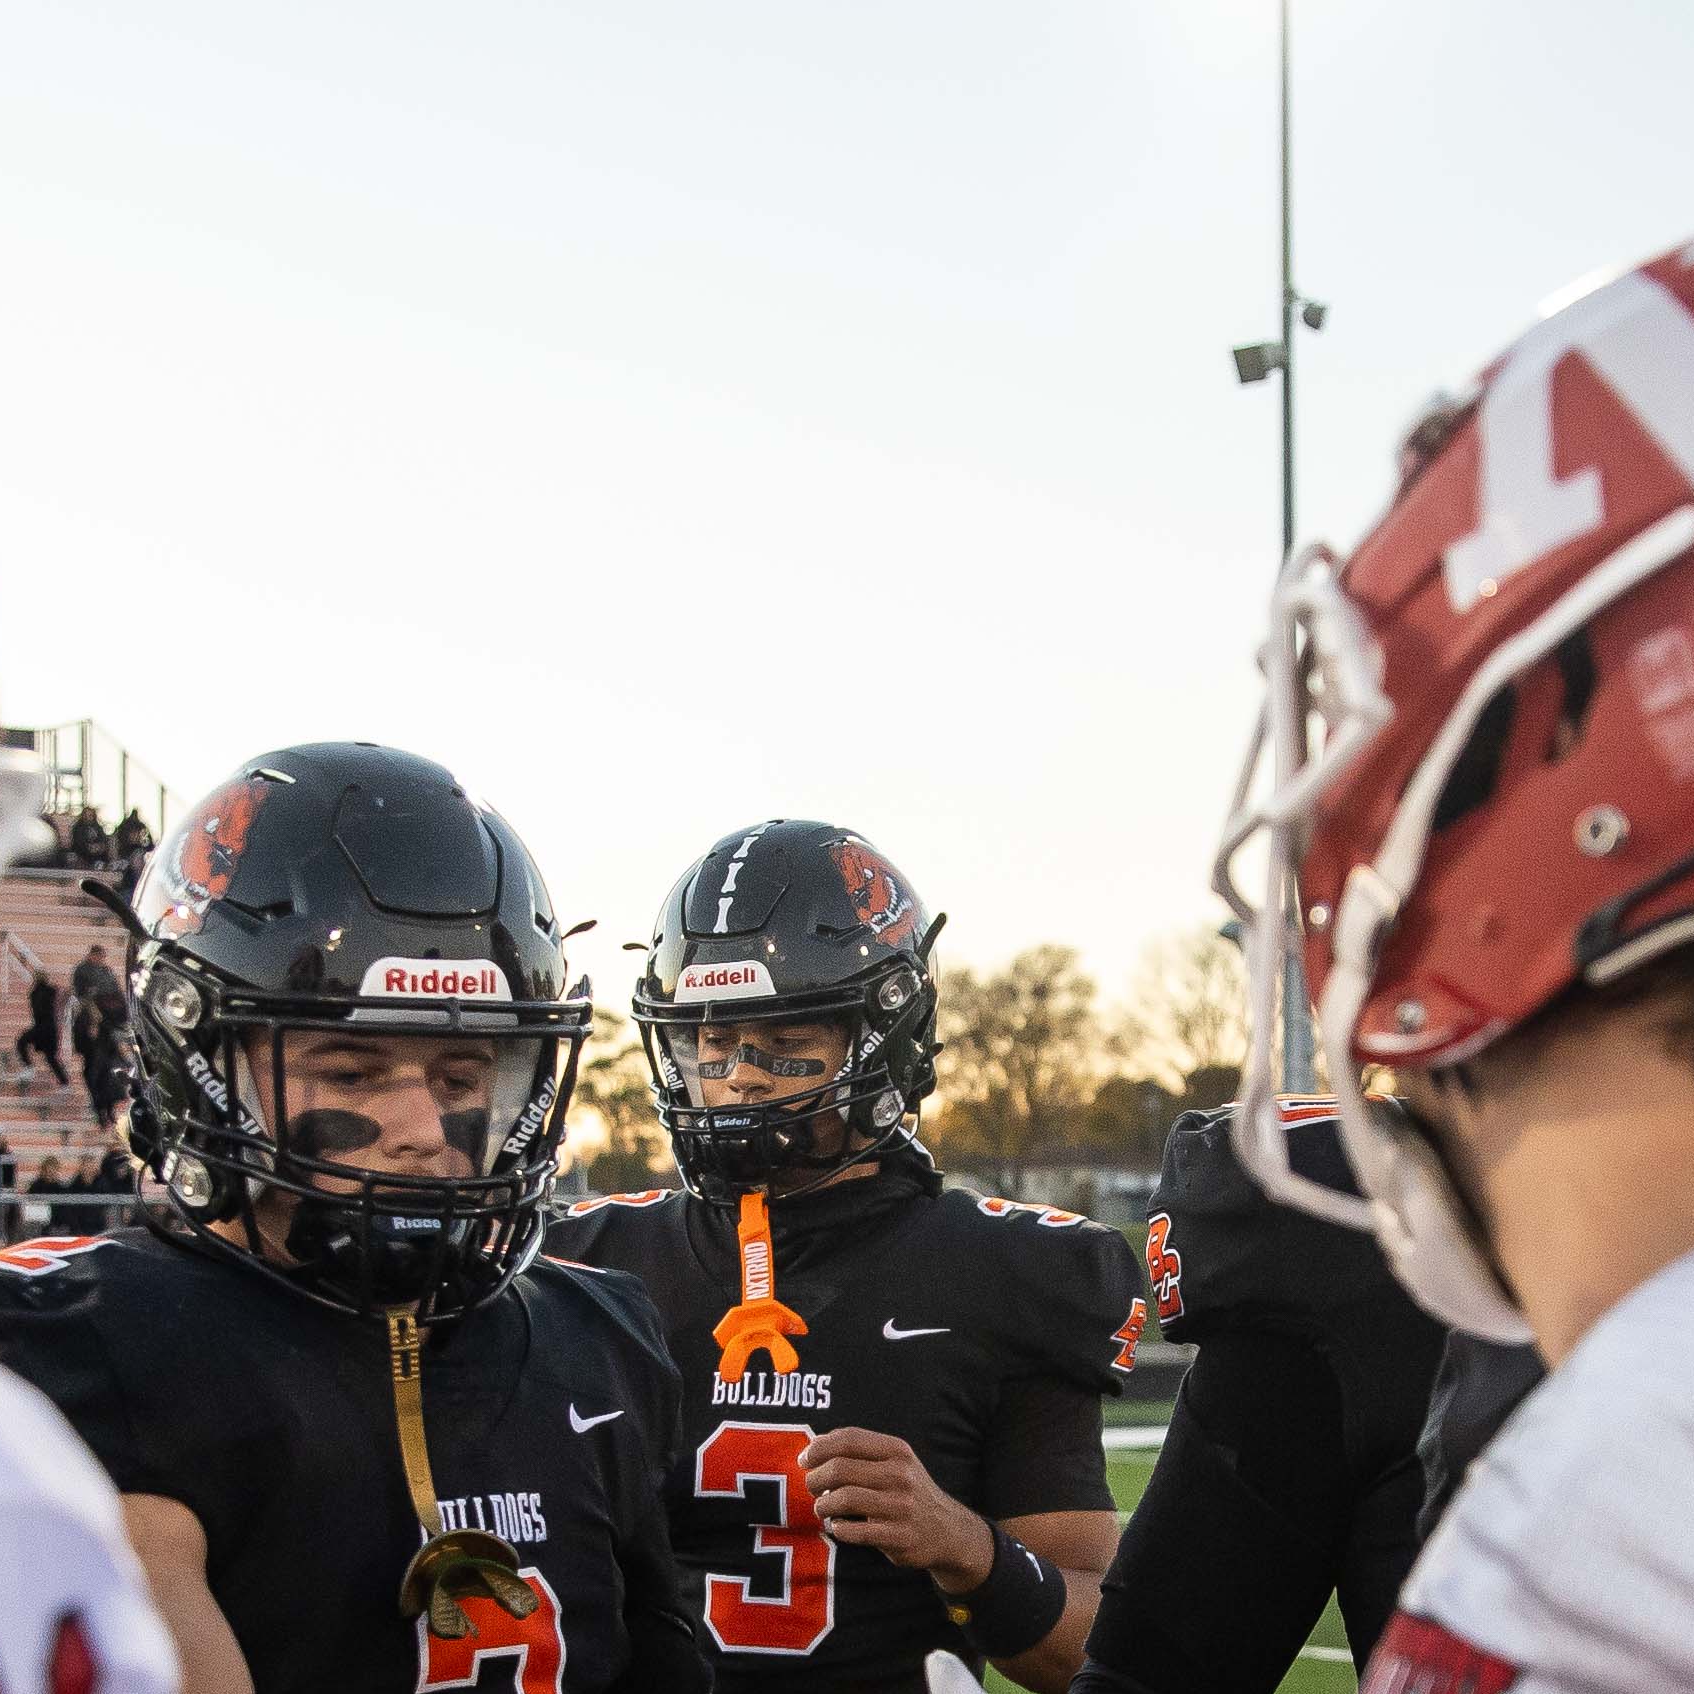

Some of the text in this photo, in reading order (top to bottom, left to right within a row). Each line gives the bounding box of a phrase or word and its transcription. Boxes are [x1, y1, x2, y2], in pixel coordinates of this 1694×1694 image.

[384, 967, 498, 994] Riddell
[185, 1050, 263, 1136] Ridll
[501, 1075, 558, 1156] Riddell
[711, 1370, 833, 1410] BULLDOGS
[420, 1491, 549, 1546] ULLDOGS
[693, 1419, 838, 1657] 3
